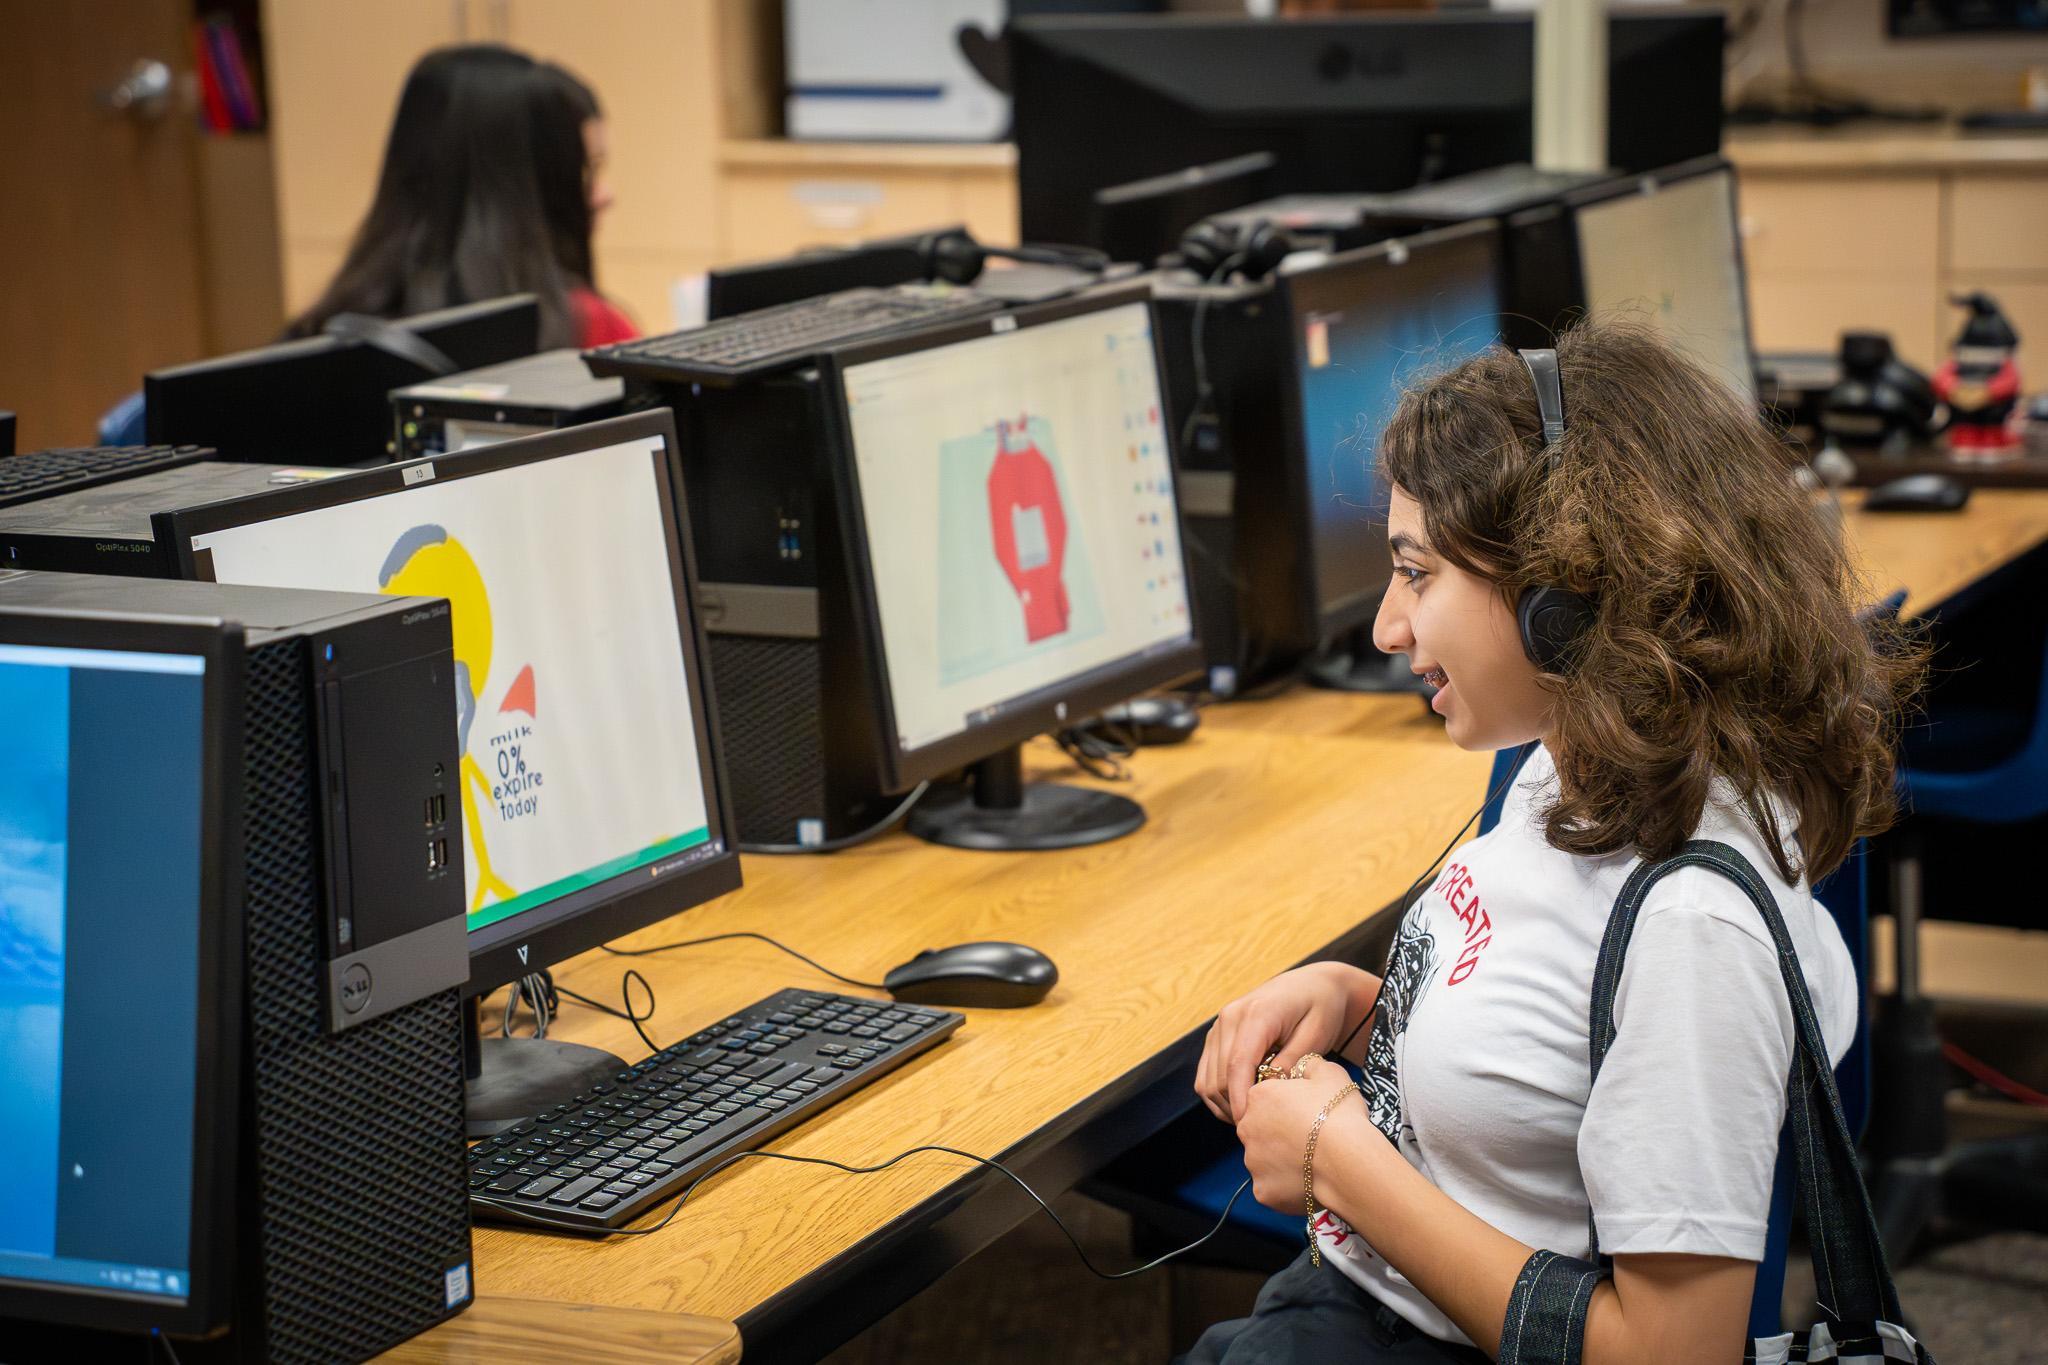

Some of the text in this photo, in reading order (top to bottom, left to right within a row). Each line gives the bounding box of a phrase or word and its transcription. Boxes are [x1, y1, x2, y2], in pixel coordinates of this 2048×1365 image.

[490, 725, 532, 746] milk
[497, 744, 526, 779] 0%
[493, 771, 543, 800] expire
[500, 795, 537, 821] today
